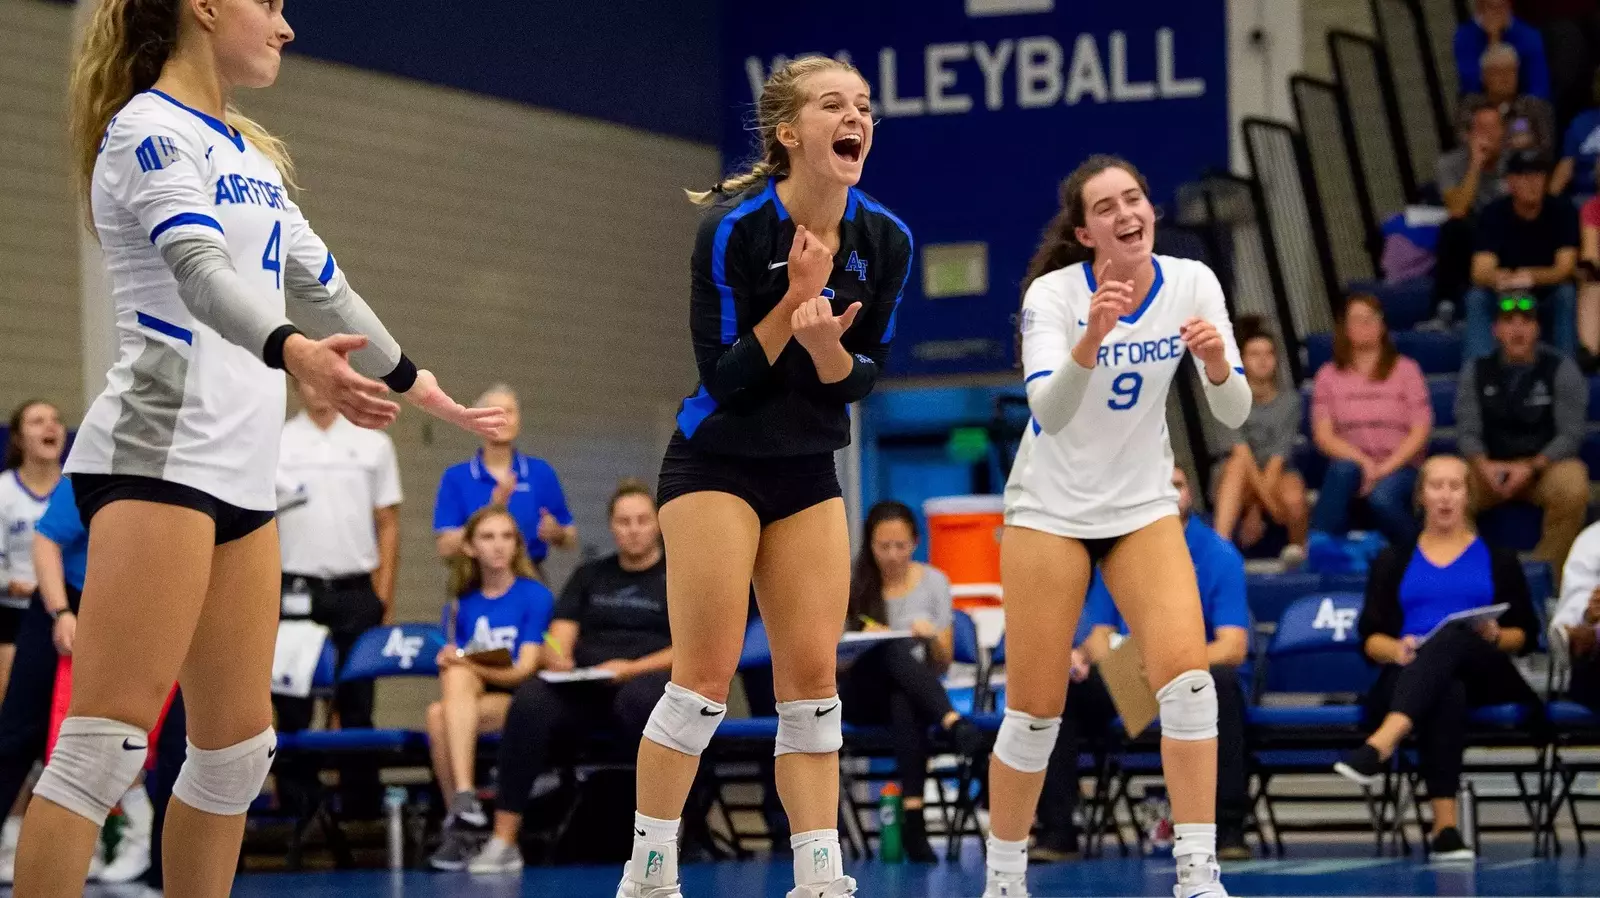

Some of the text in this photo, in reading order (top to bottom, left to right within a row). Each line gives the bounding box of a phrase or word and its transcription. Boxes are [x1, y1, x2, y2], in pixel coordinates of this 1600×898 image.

[745, 27, 1206, 120] VLEYBALL
[214, 173, 287, 212] AIR FOR
[262, 220, 282, 290] 4
[1113, 335, 1182, 366] FORCE
[1107, 371, 1143, 411] 9
[1311, 597, 1359, 642] AF
[381, 627, 425, 670] AF
